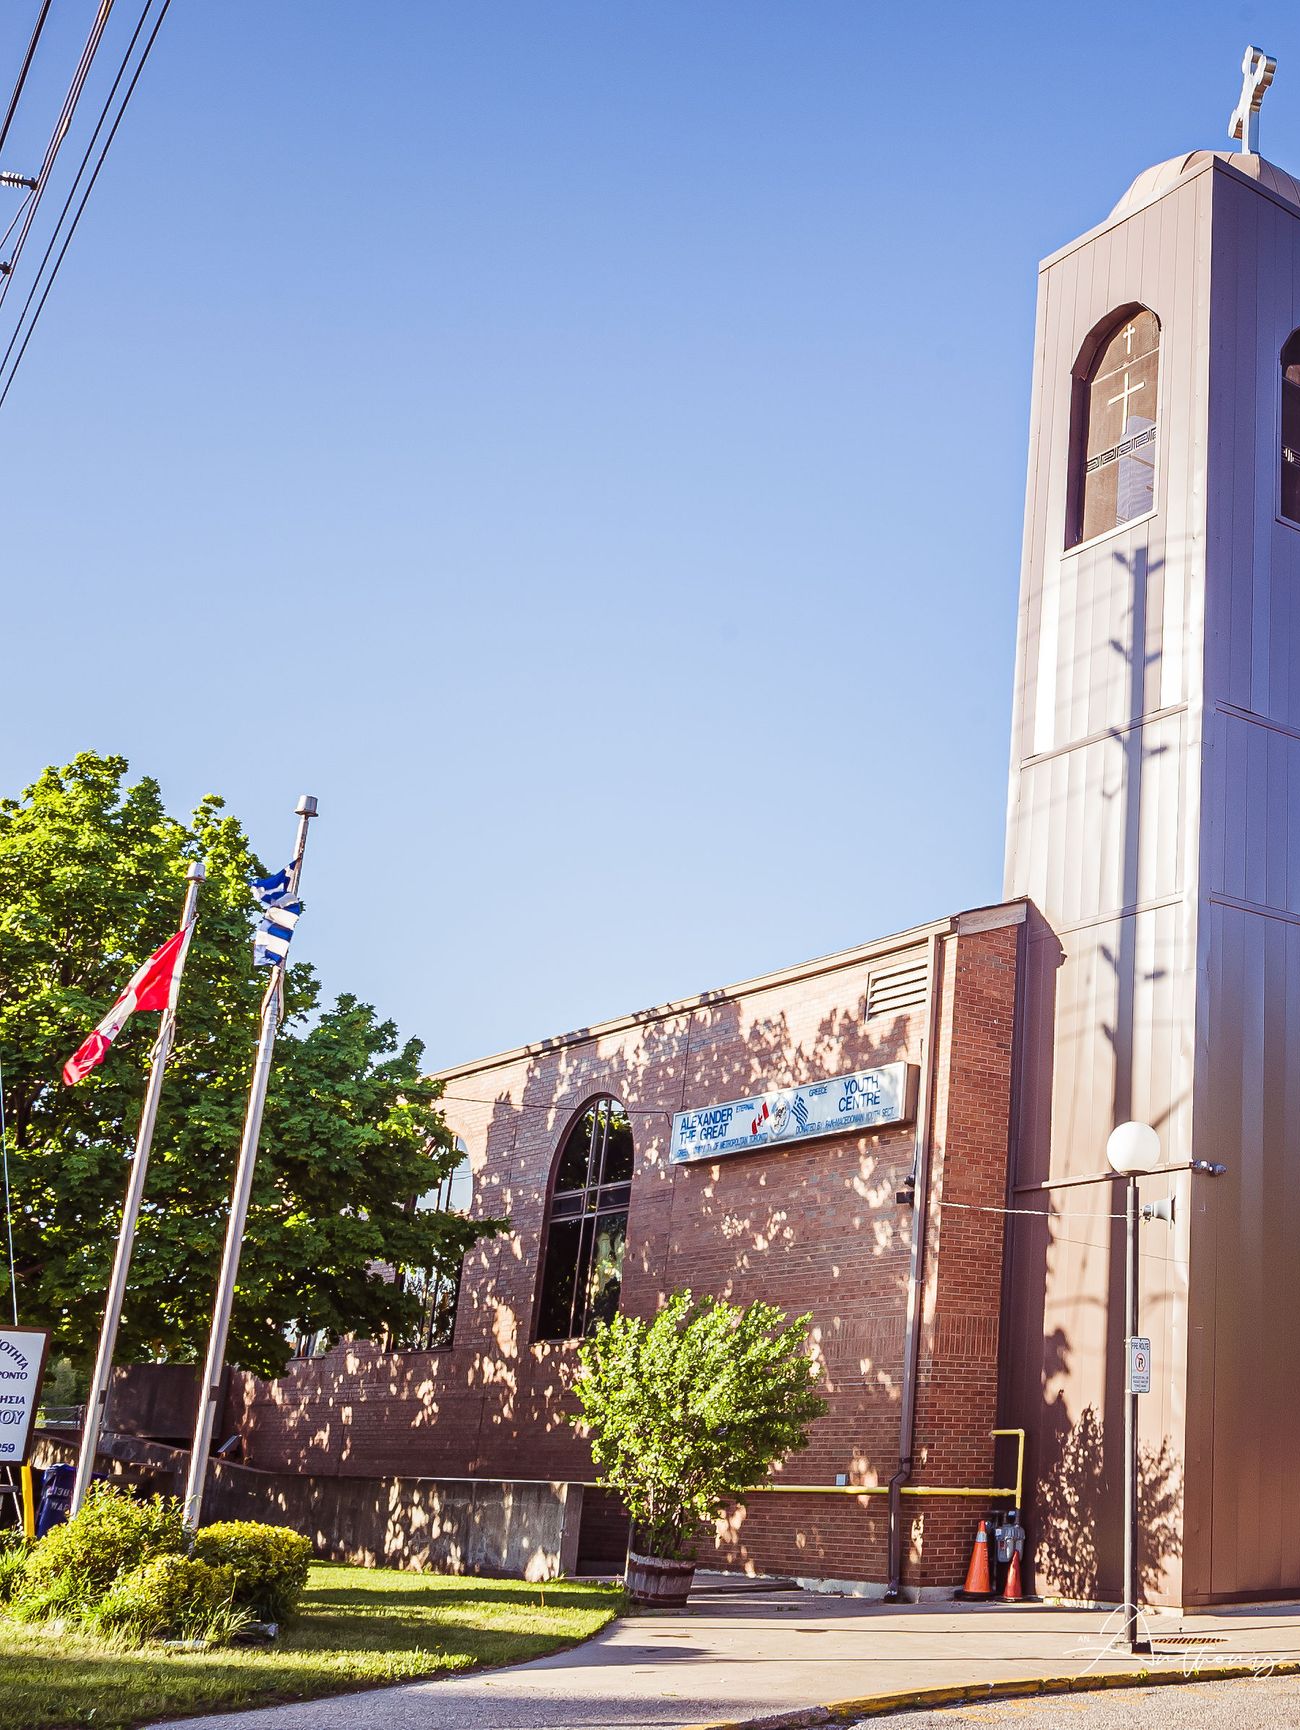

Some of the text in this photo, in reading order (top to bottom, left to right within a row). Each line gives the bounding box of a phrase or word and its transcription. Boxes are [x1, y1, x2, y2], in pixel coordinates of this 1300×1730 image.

[844, 1075, 879, 1095] YOUTH
[838, 1089, 881, 1112] CENTRE
[681, 1107, 734, 1131] ALEXANDER
[679, 1122, 730, 1145] THE GREAT
[0, 1339, 29, 1371] ΟΤΗΤΑ
[0, 1410, 25, 1425] ΟΥ
